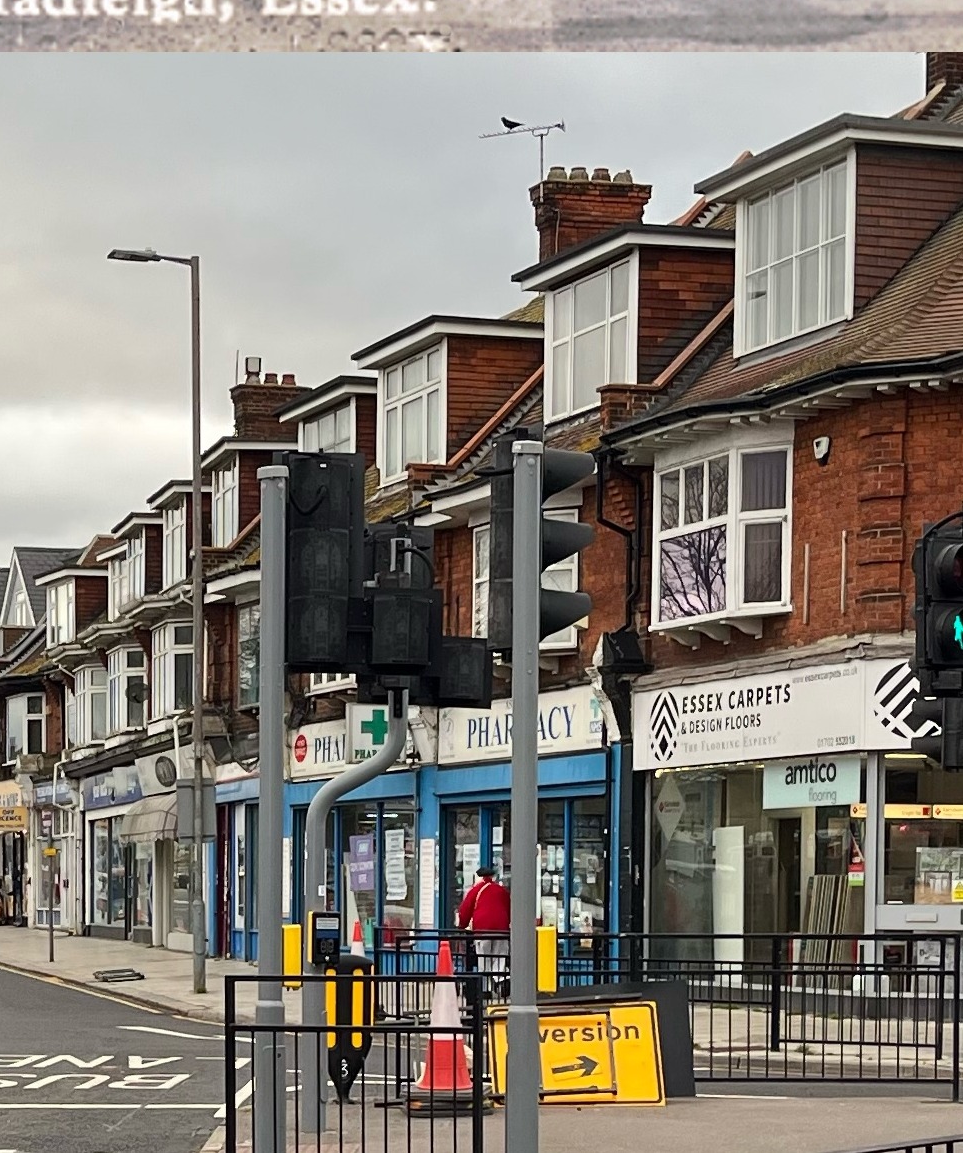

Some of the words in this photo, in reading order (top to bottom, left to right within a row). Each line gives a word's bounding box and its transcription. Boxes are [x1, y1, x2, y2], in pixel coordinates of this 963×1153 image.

[681, 691, 723, 715] ESSEX
[728, 683, 791, 710] CARPETS
[467, 703, 577, 749] PHARACY
[680, 722, 687, 735] &
[689, 717, 723, 734] DESIGN
[725, 713, 762, 731] FLOORS
[784, 756, 837, 785] amtico
[808, 786, 838, 804] flooring
[538, 1021, 640, 1044] version
